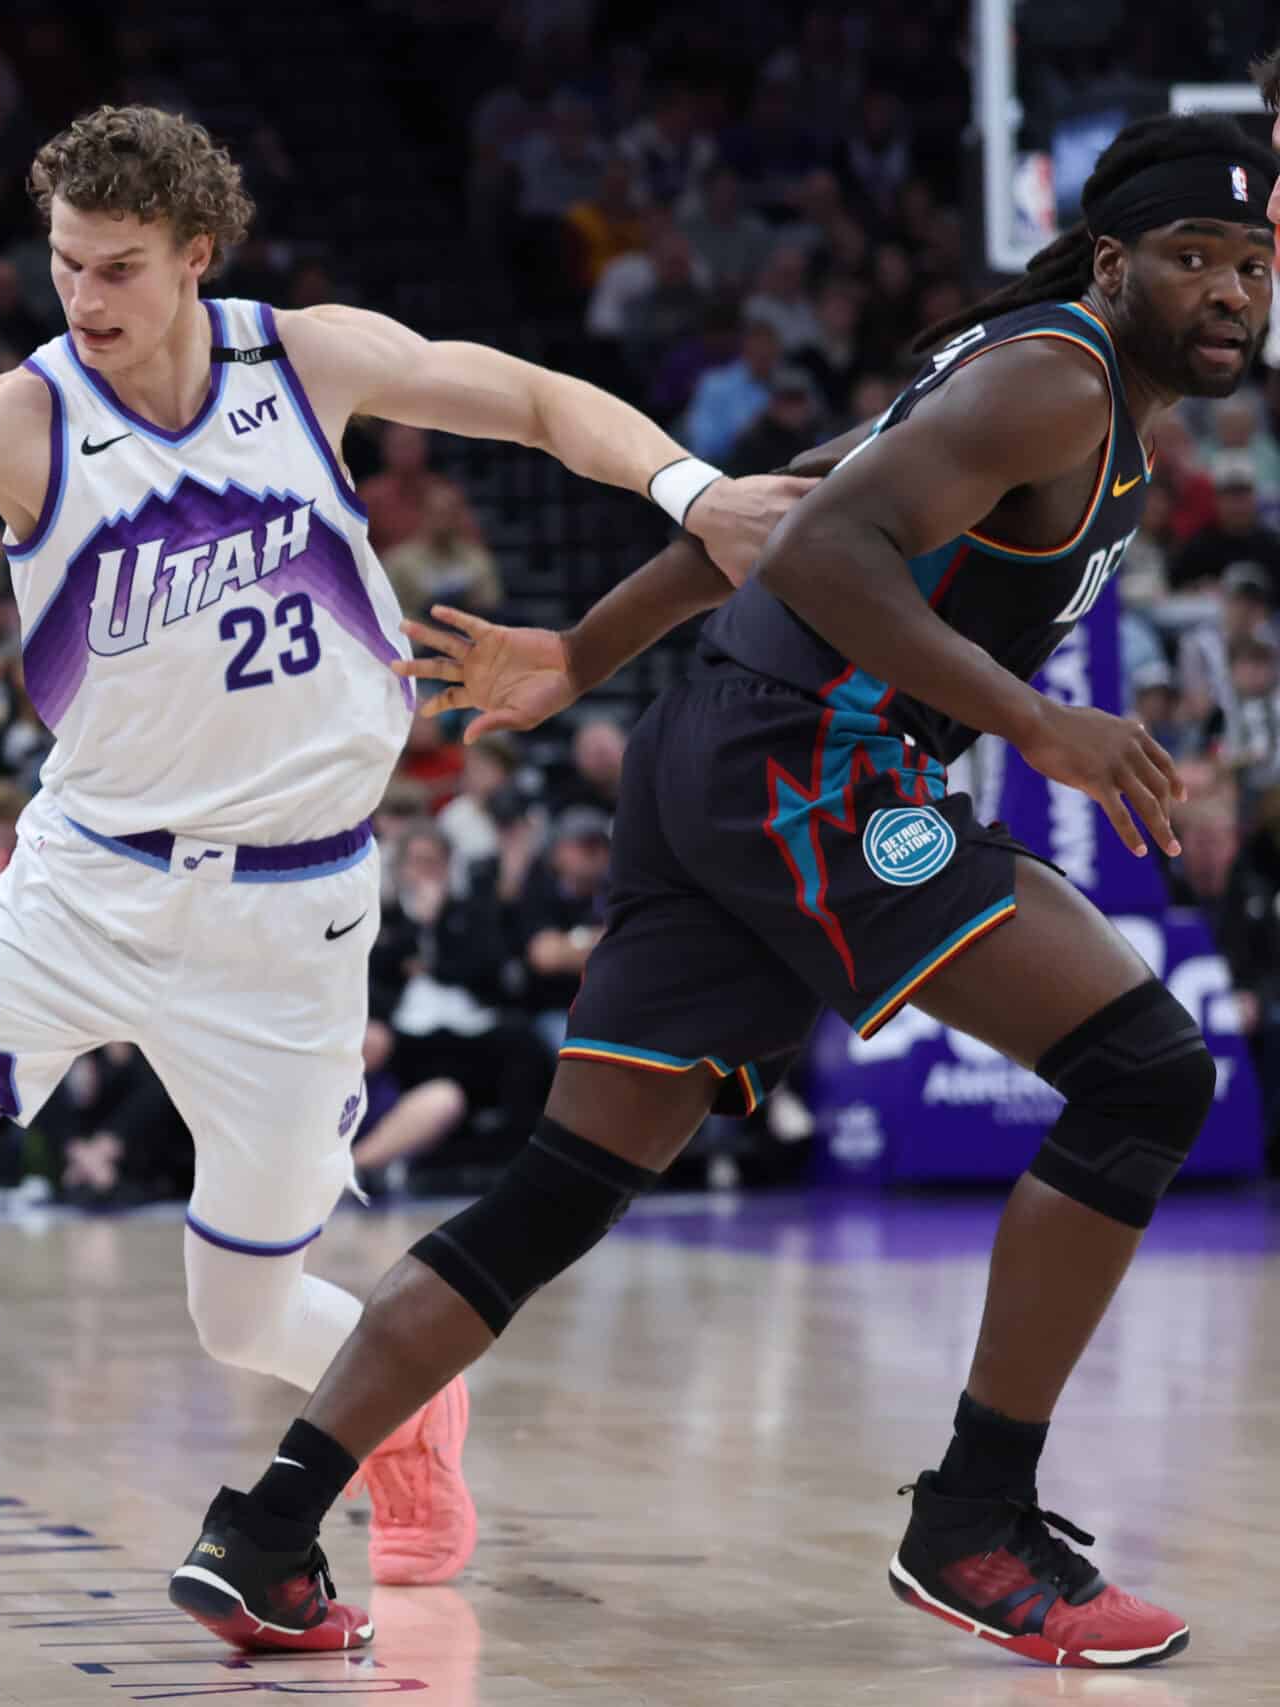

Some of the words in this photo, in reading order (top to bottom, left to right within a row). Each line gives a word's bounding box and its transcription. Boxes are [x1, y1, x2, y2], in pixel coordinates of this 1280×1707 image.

[228, 394, 278, 435] LVT
[86, 498, 317, 657] UTAH
[218, 592, 321, 692] 23
[880, 819, 928, 854] DETROIT
[888, 830, 937, 865] PISTONS
